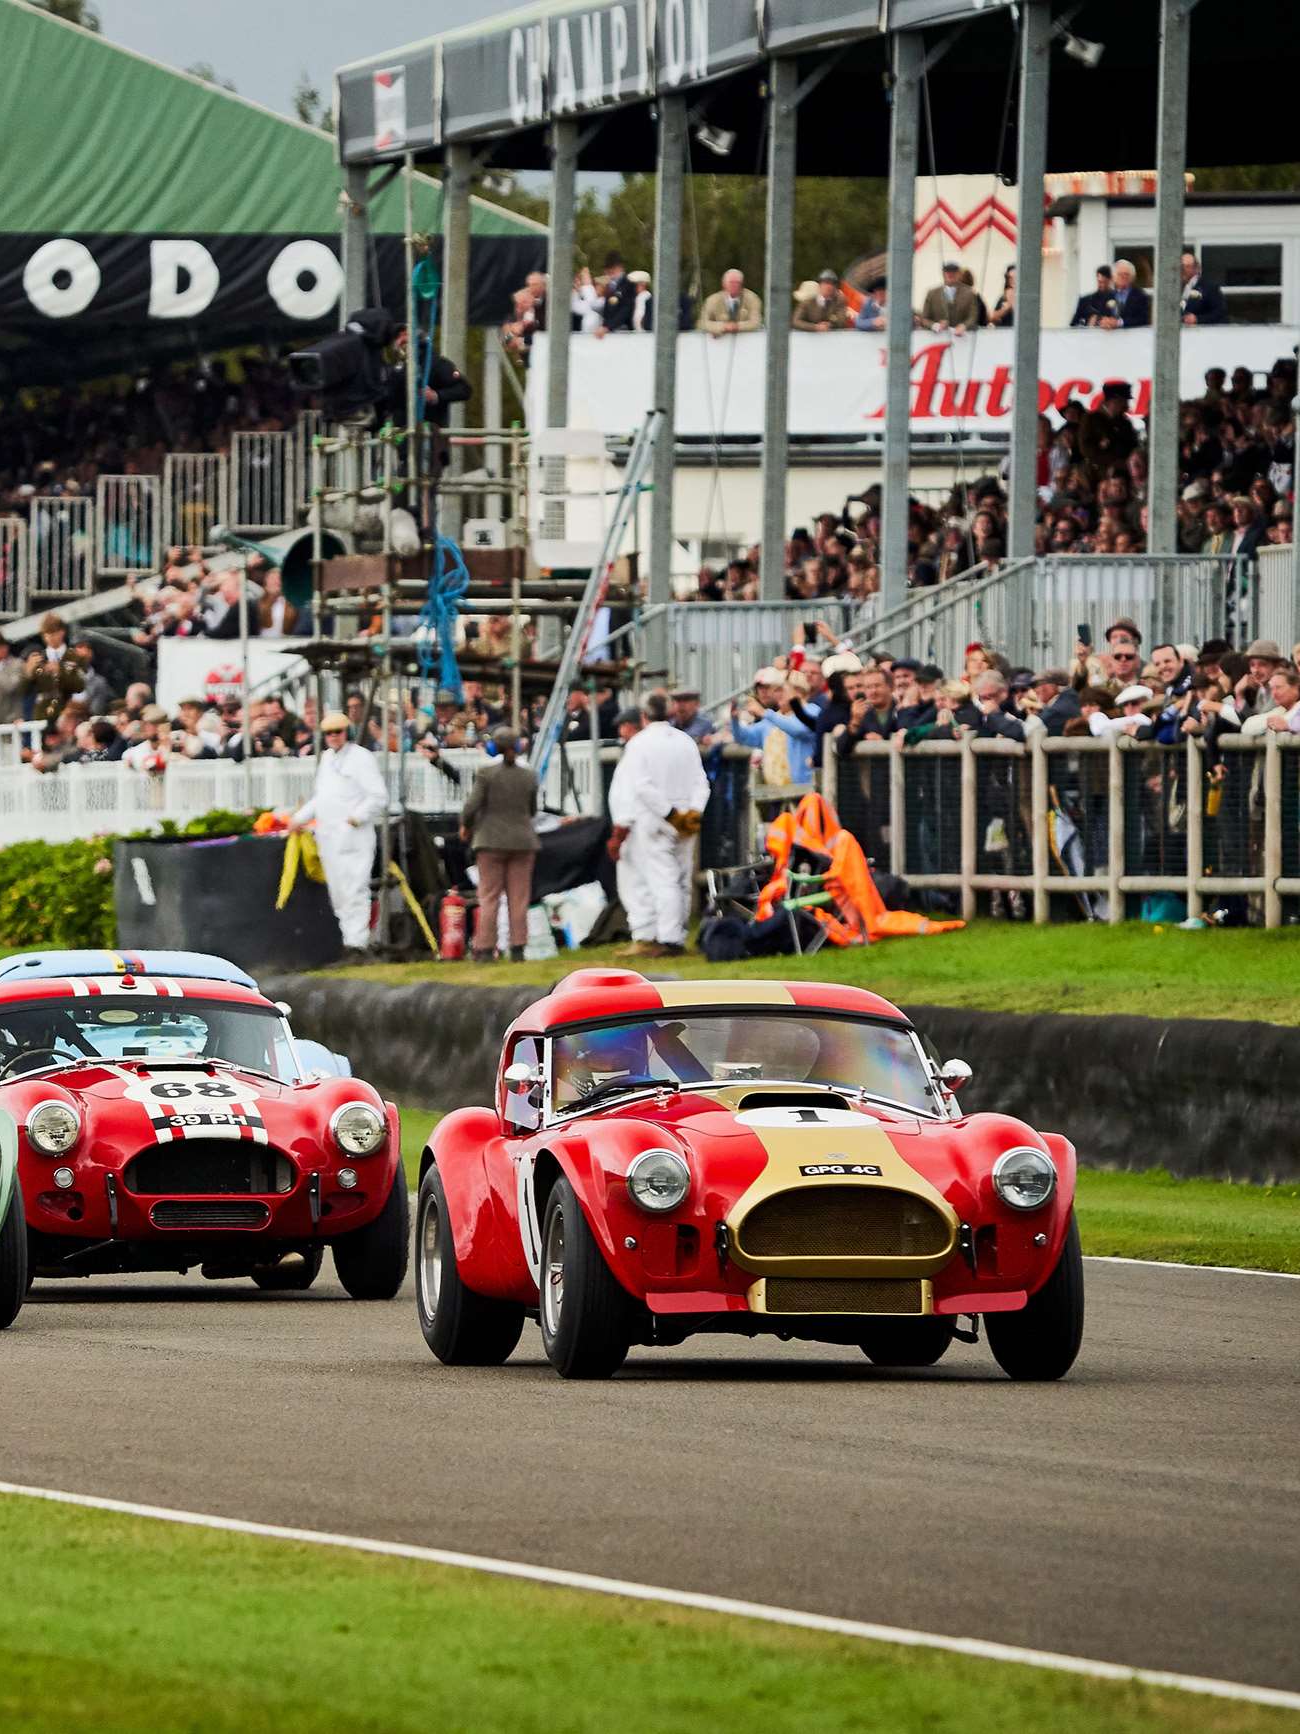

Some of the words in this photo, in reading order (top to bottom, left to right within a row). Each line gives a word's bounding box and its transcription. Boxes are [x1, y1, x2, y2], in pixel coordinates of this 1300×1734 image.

[508, 0, 709, 126] CHAMPION
[150, 1081, 237, 1098] 68
[169, 1114, 202, 1126] 39
[209, 1114, 248, 1126] PH
[787, 1109, 829, 1123] 1
[804, 1165, 845, 1175] GPG
[852, 1166, 878, 1175] 4C
